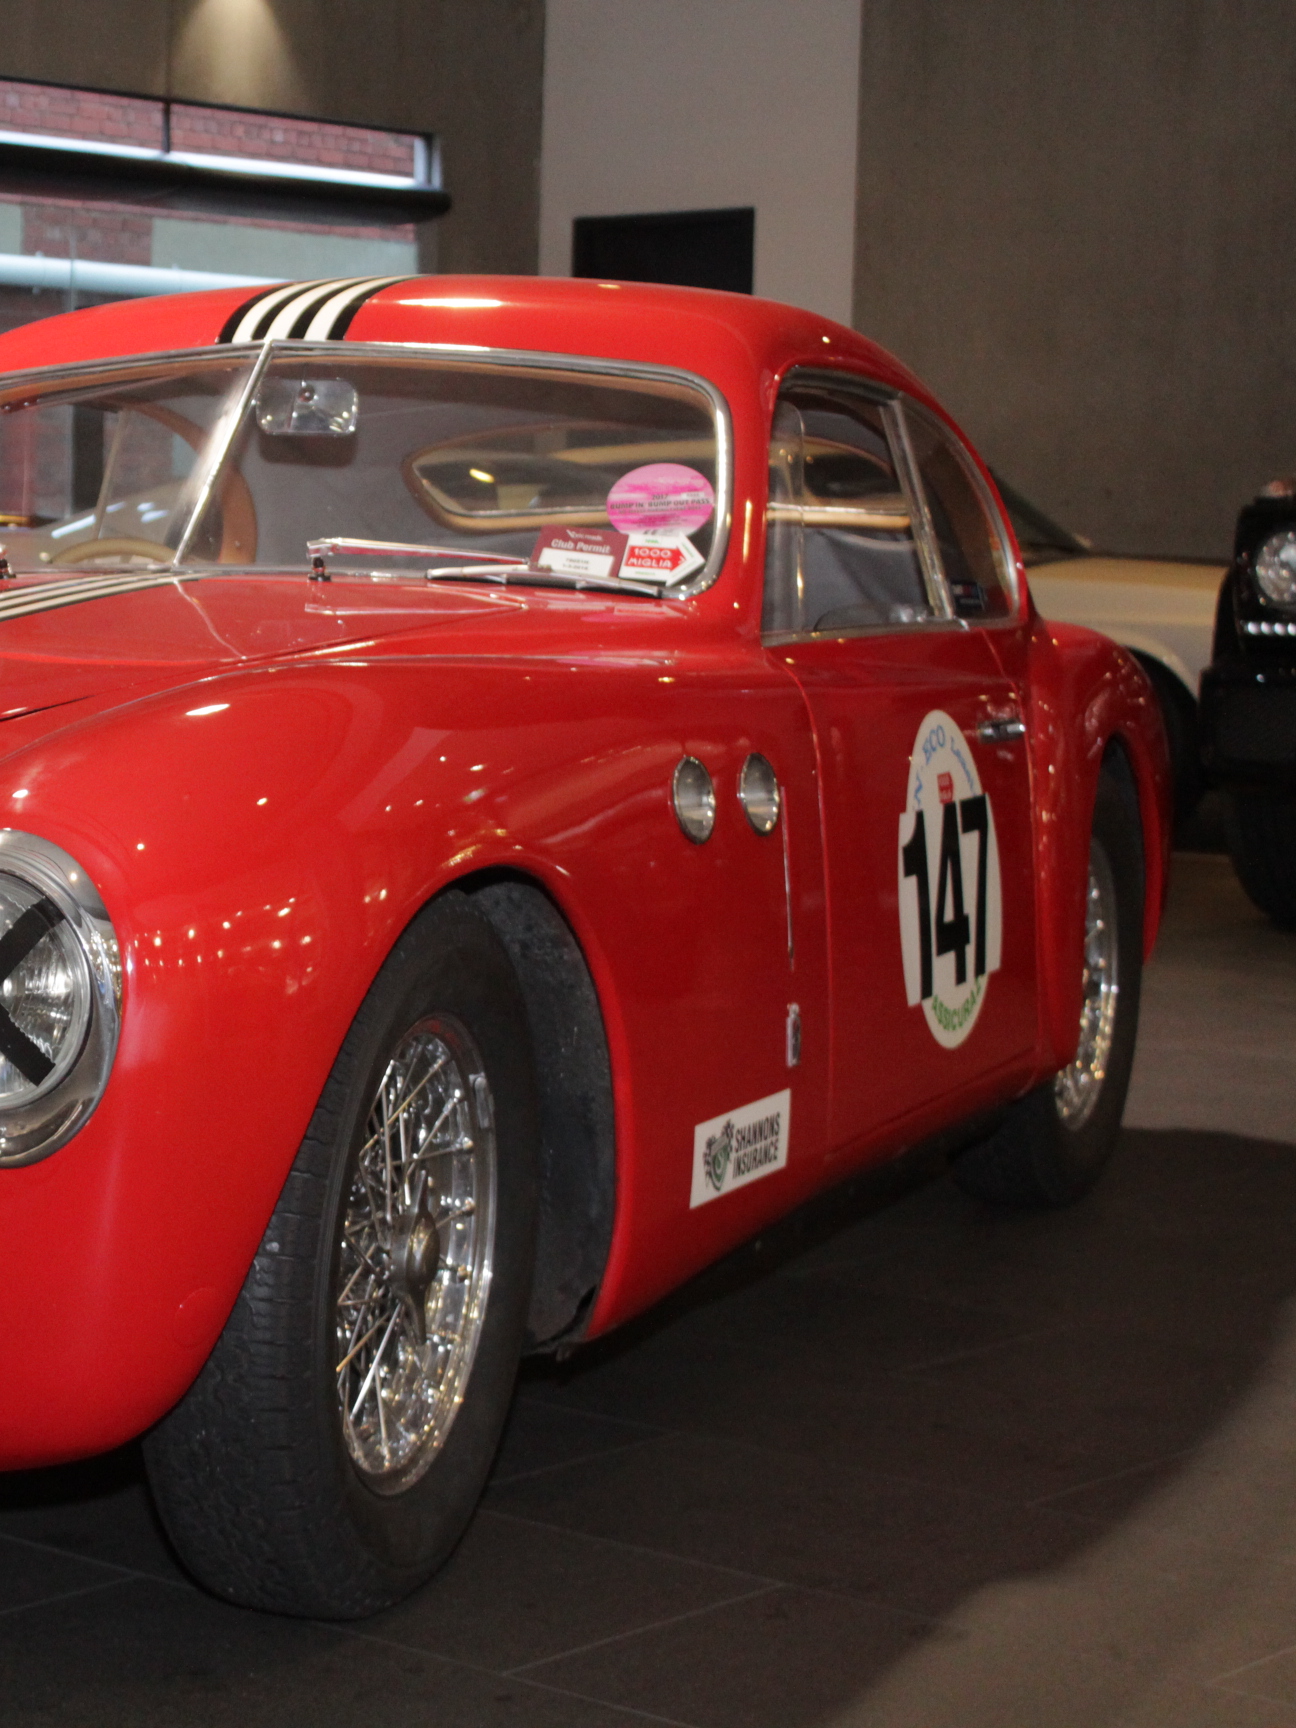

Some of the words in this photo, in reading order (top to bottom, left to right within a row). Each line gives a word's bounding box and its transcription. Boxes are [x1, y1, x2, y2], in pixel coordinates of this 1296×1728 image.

[610, 502, 634, 510] BUMP
[648, 500, 672, 508] BUMP
[551, 538, 575, 550] Club
[576, 541, 611, 554] Permit
[634, 548, 672, 558] 1000
[627, 557, 673, 568] MIGLIA
[922, 724, 946, 766] ECO
[902, 794, 989, 1001] 147
[734, 1111, 781, 1154] SHANNONS
[732, 1138, 779, 1179] INSURANCE
